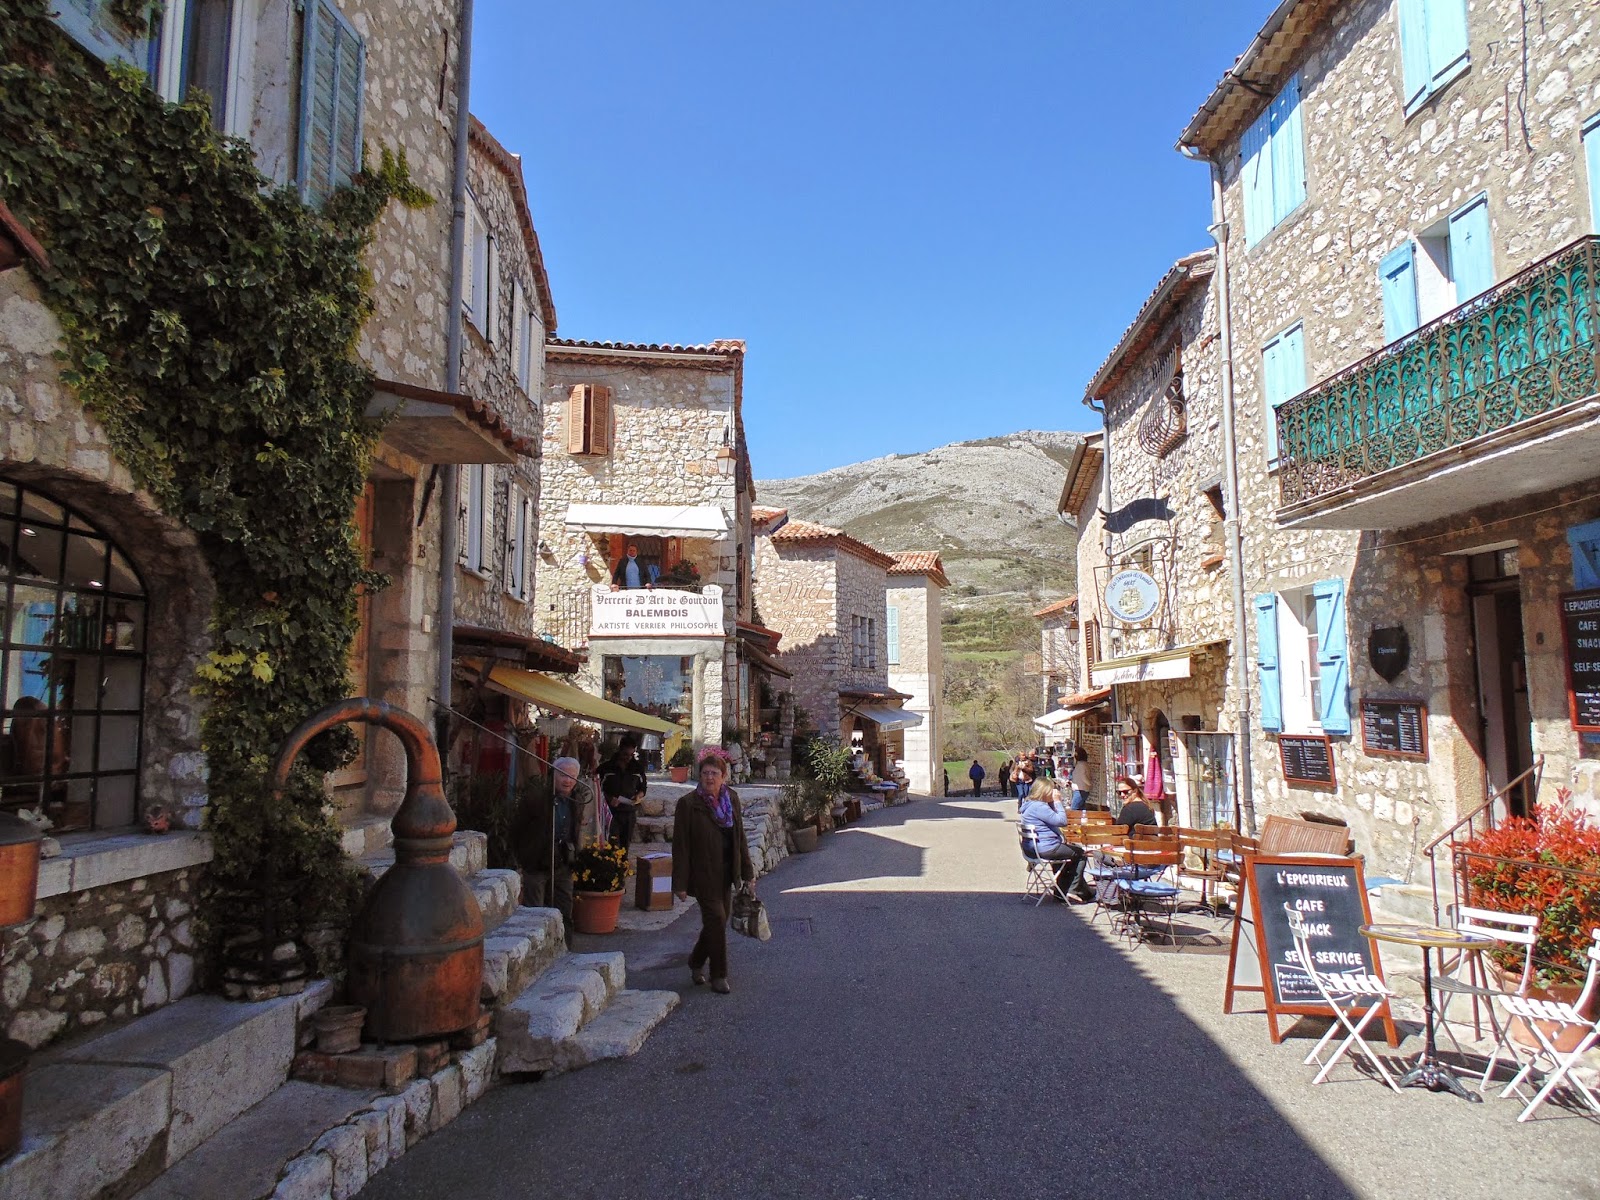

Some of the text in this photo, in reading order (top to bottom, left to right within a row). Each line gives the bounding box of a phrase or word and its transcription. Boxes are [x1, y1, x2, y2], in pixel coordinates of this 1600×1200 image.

[596, 595, 632, 605] Verrerie
[667, 595, 677, 605] de
[679, 594, 719, 605] Gourdon
[626, 609, 688, 617] BALEMBOIS
[598, 622, 719, 630] ARTISTE VERRIER PHILOSOPHE
[1578, 620, 1597, 630] CAFE
[1277, 870, 1348, 887] L'EPICURIEUX
[1295, 899, 1324, 911] CAFE
[1301, 923, 1332, 936] NACK
[1284, 950, 1362, 965] SE-SERVICE
